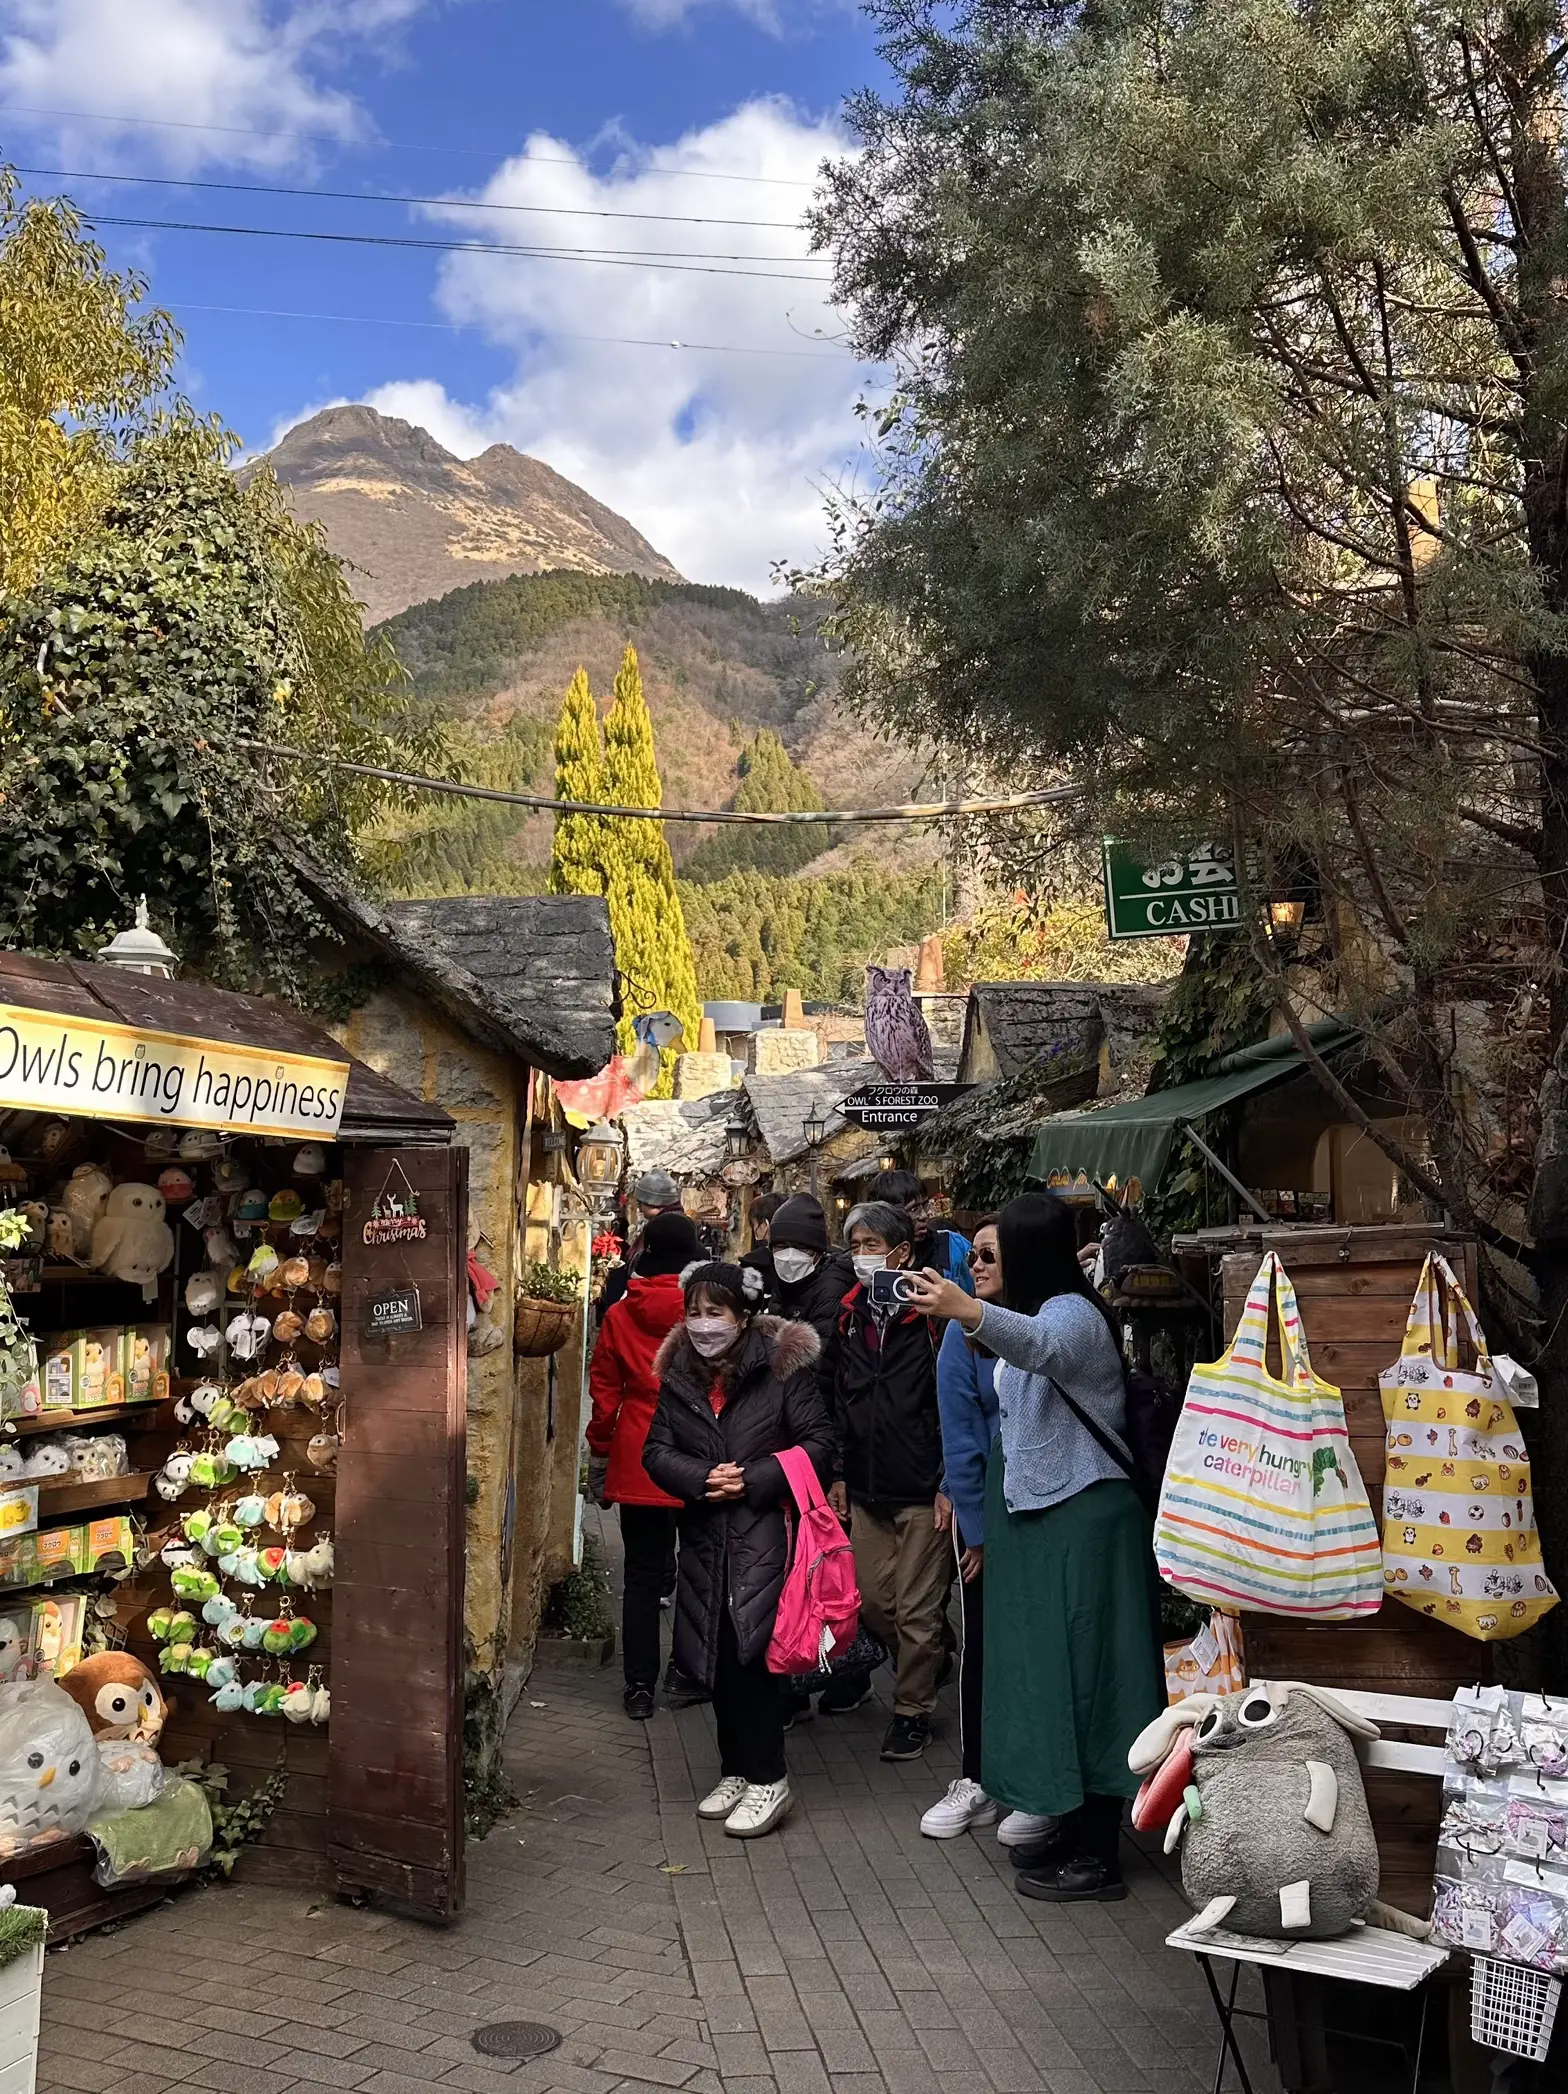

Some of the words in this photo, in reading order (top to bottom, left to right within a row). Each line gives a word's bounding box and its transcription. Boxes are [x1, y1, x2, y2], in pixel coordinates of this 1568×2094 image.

[1146, 895, 1239, 926] CASHI
[0, 1026, 83, 1088] Owls
[92, 1039, 185, 1114] bring
[193, 1055, 340, 1122] happiness
[868, 1086, 919, 1096] フクロウの森
[882, 1096, 915, 1105] FOREST
[918, 1095, 938, 1105] ZOO
[861, 1110, 918, 1123] Entrance
[363, 1218, 427, 1245] Christmas
[373, 1299, 408, 1316] OPEN
[1219, 1434, 1258, 1463] very
[1258, 1444, 1314, 1482] hungry
[1203, 1453, 1300, 1495] caterpillar
